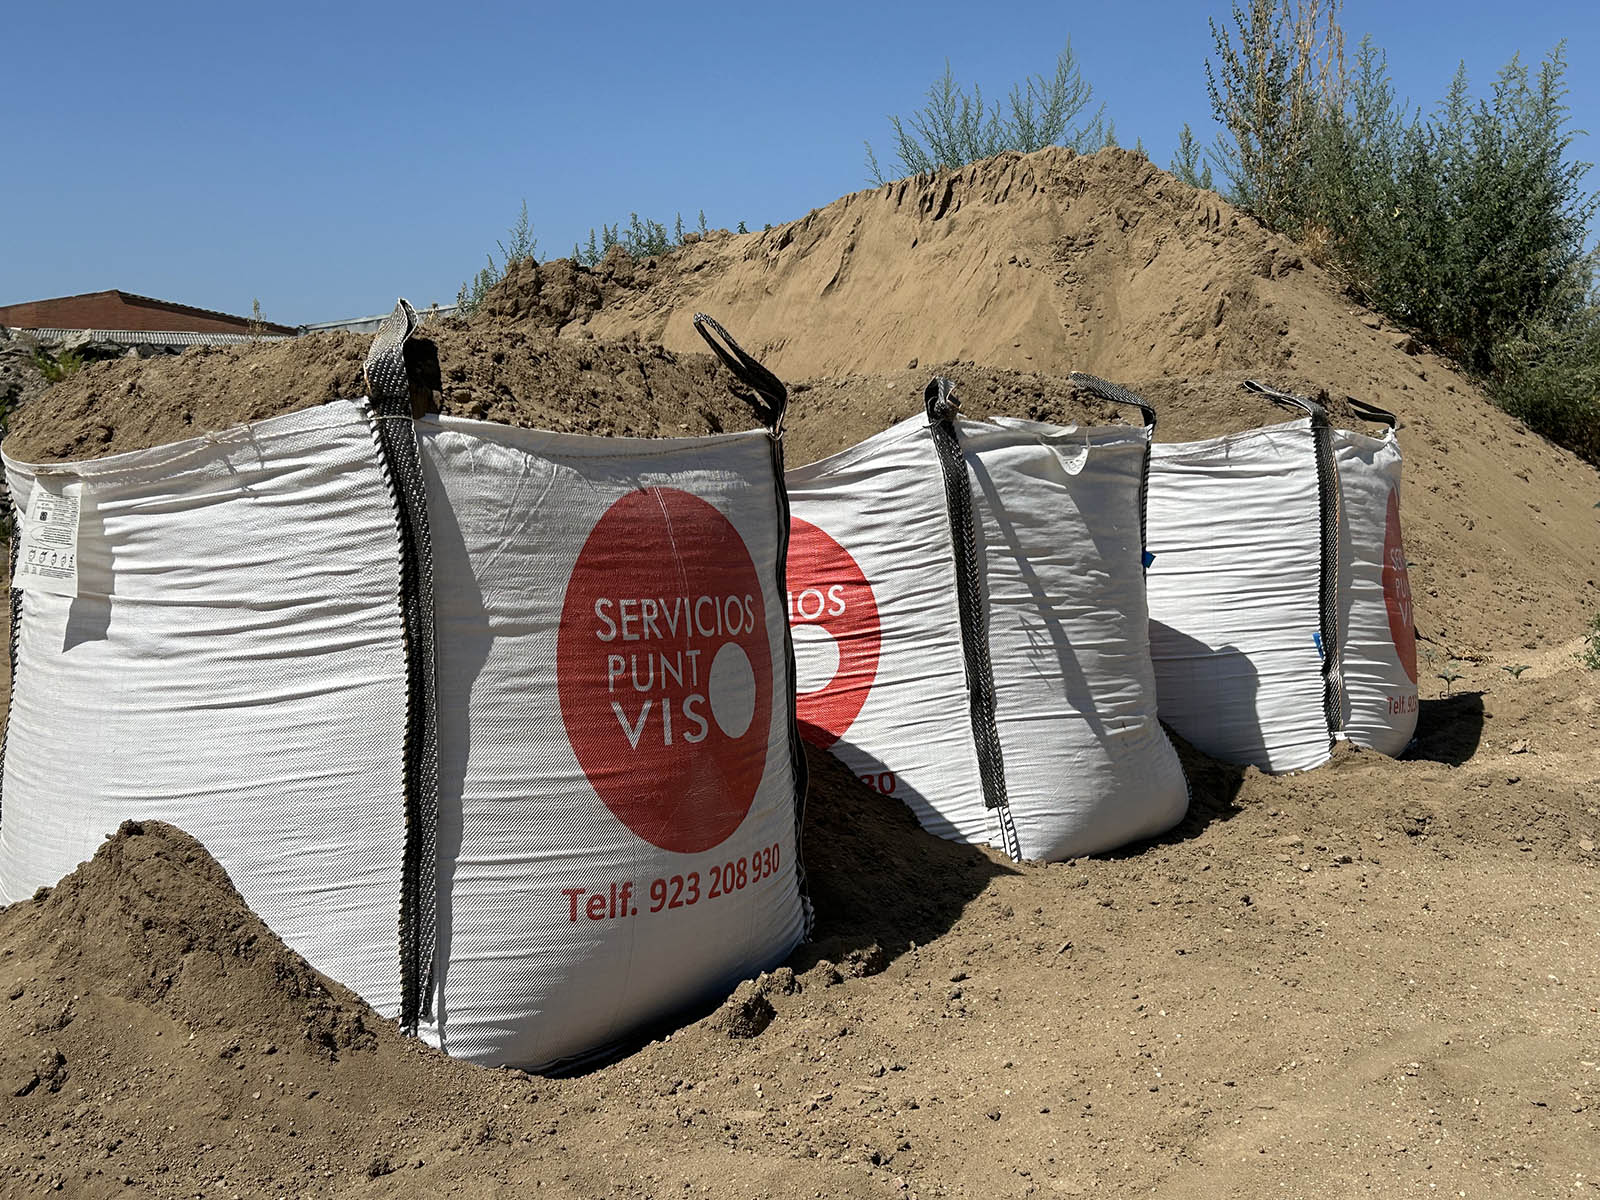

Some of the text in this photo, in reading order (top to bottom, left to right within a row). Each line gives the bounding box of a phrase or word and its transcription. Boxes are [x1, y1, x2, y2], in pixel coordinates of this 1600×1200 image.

[594, 594, 754, 641] SERVICIOS
[561, 843, 780, 922] Telf. 923 208 930
